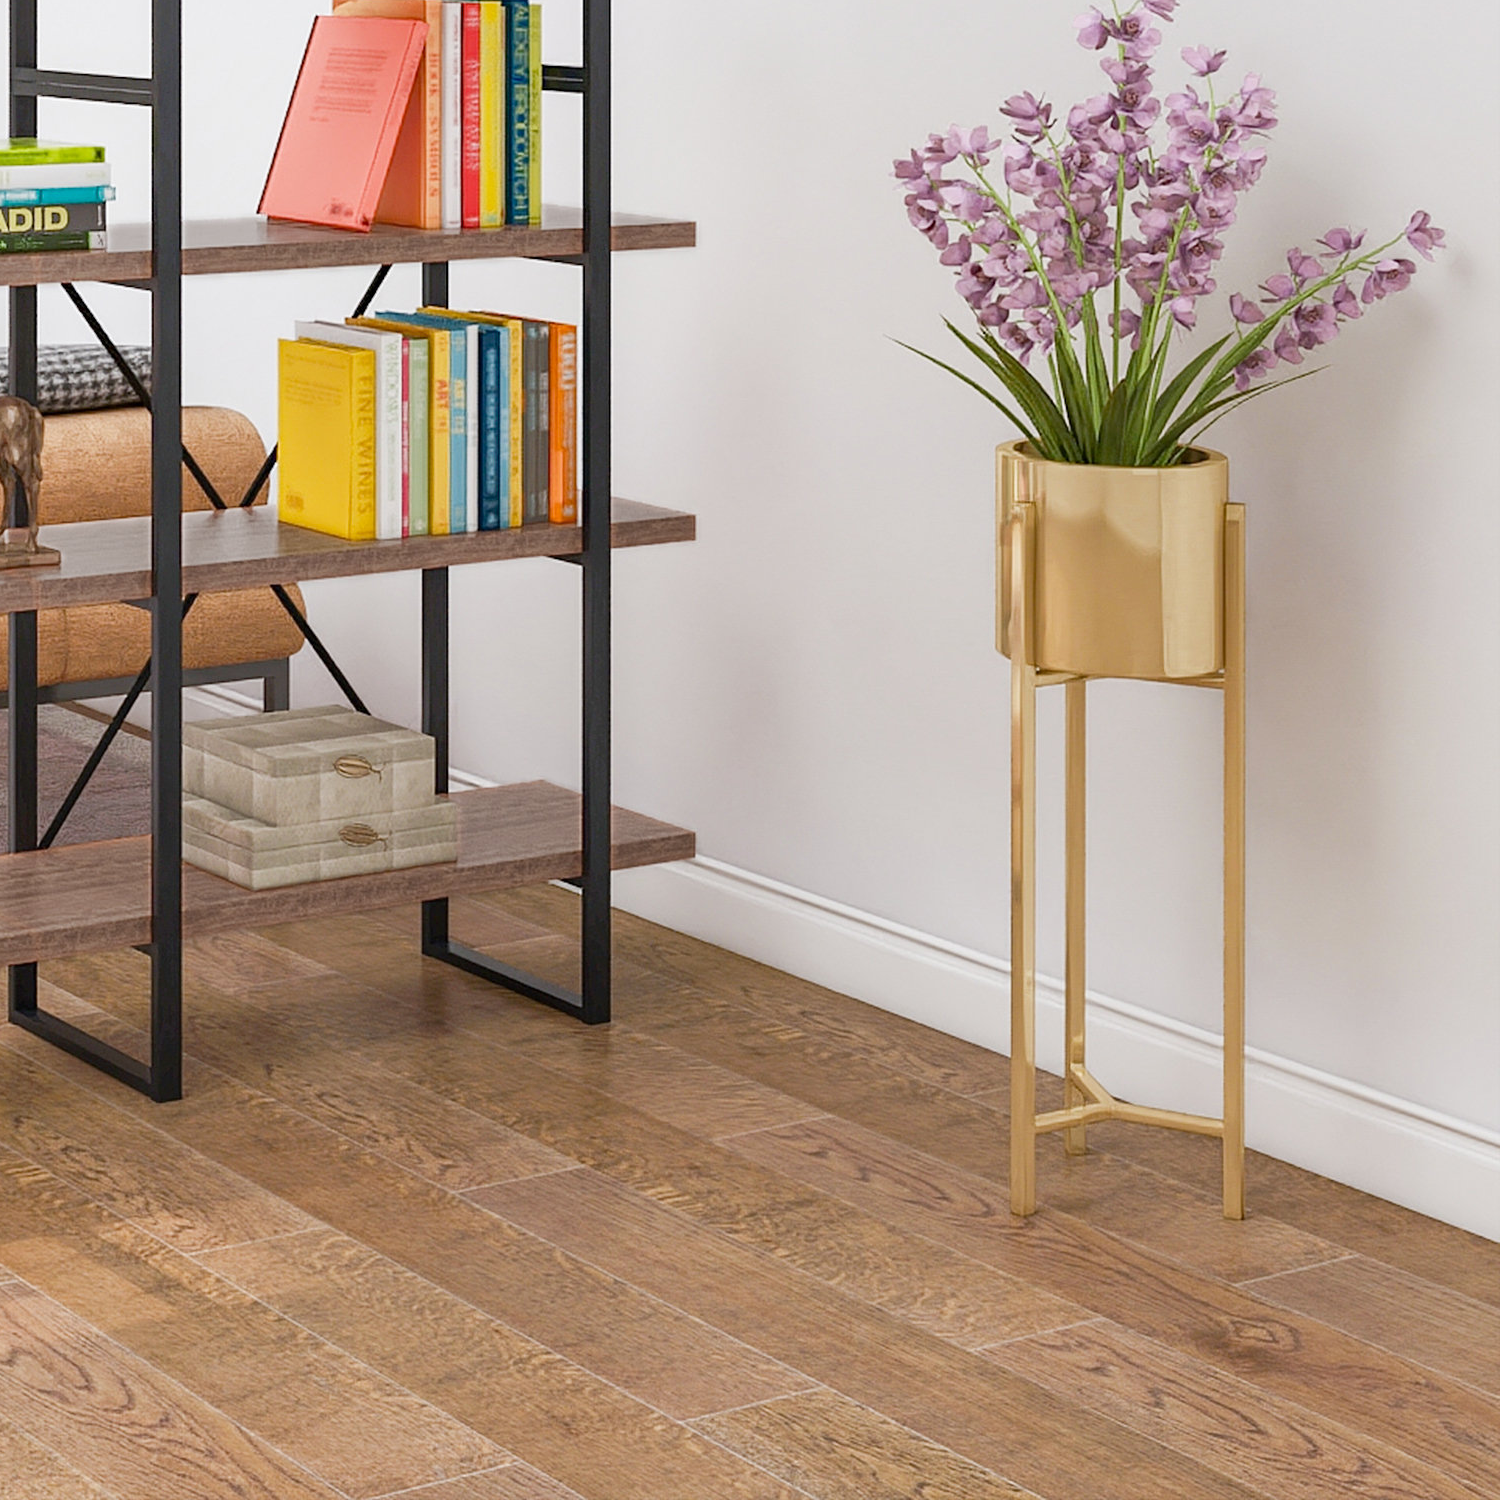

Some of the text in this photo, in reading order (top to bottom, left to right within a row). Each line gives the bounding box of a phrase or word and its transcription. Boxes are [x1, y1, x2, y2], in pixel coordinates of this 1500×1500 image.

[436, 379, 449, 410] ART
[357, 374, 373, 515] FINE WINES
